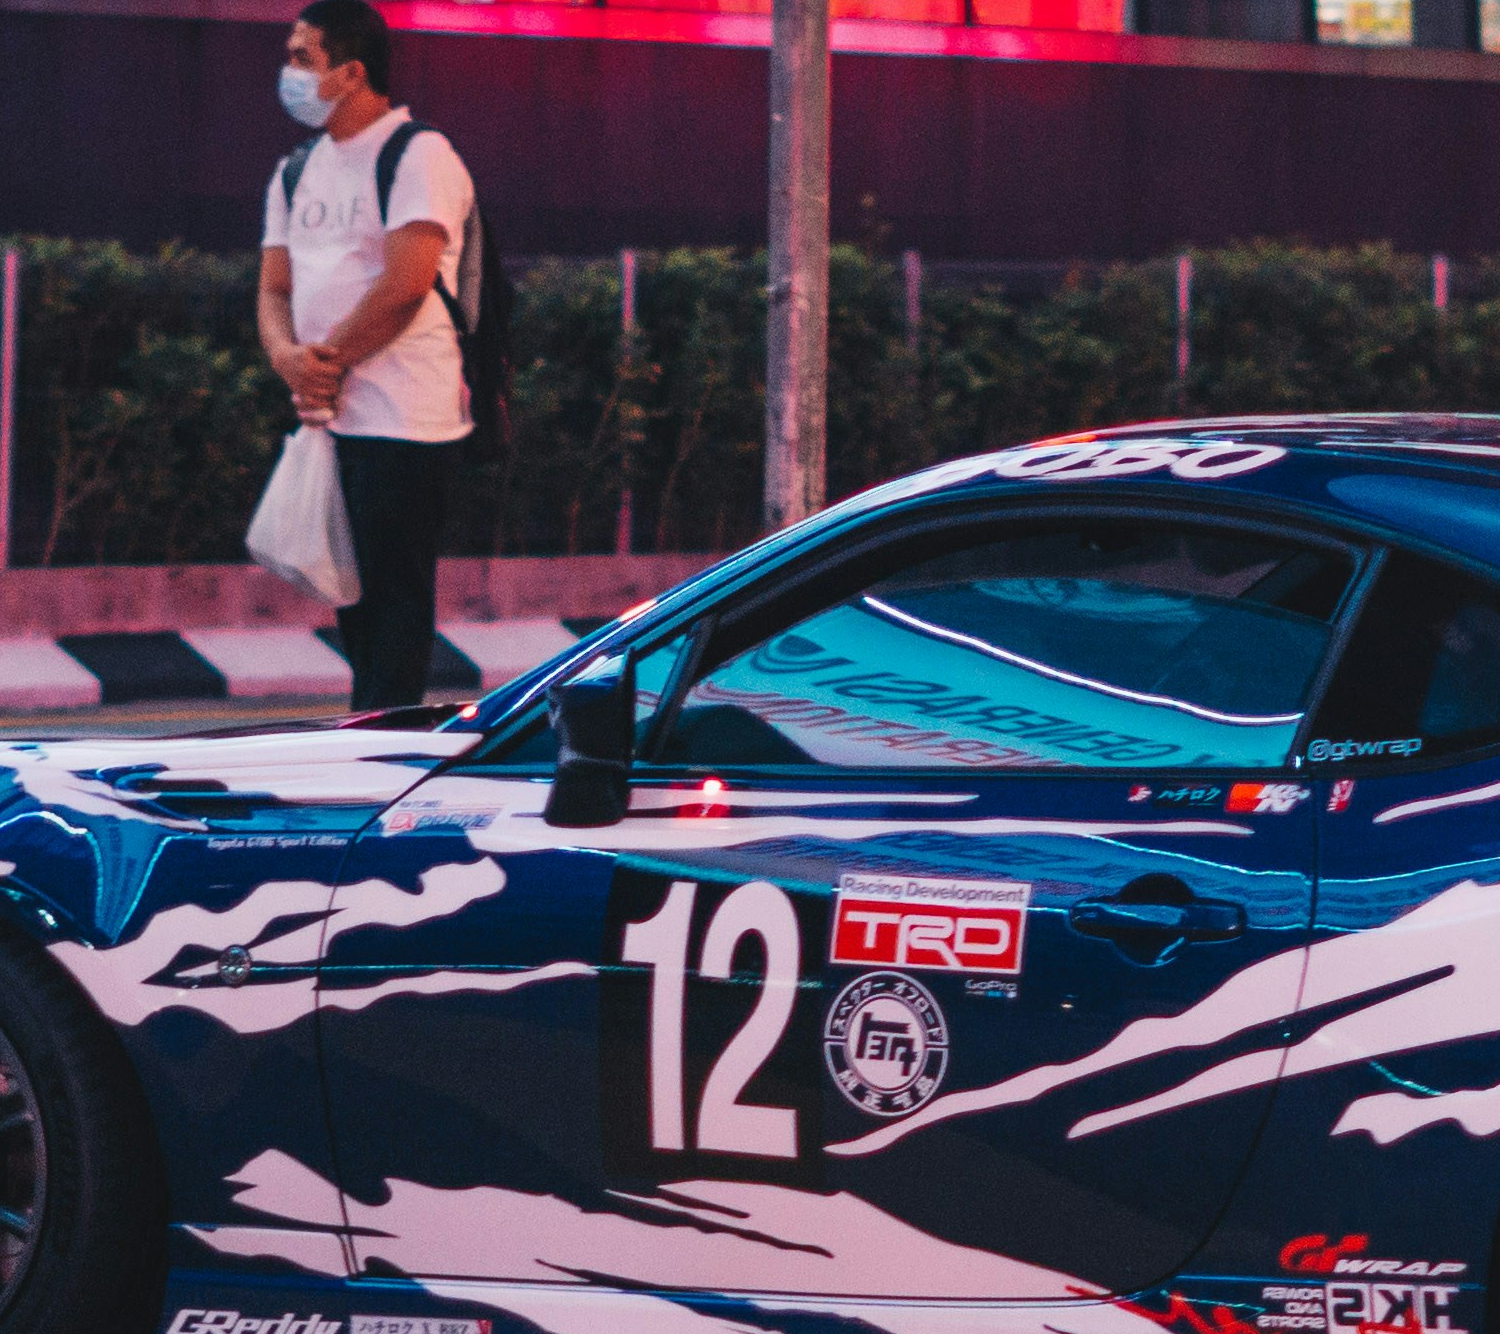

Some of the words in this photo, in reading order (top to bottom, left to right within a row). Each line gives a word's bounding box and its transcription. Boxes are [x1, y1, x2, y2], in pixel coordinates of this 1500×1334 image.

[1306, 736, 1423, 763] @gtwrap
[843, 875, 903, 901] Racing
[905, 880, 1026, 904] Development
[844, 909, 1012, 968] TRD
[963, 978, 1019, 991] GoPro
[621, 879, 800, 1158] 12
[1333, 1258, 1468, 1276] WRAP
